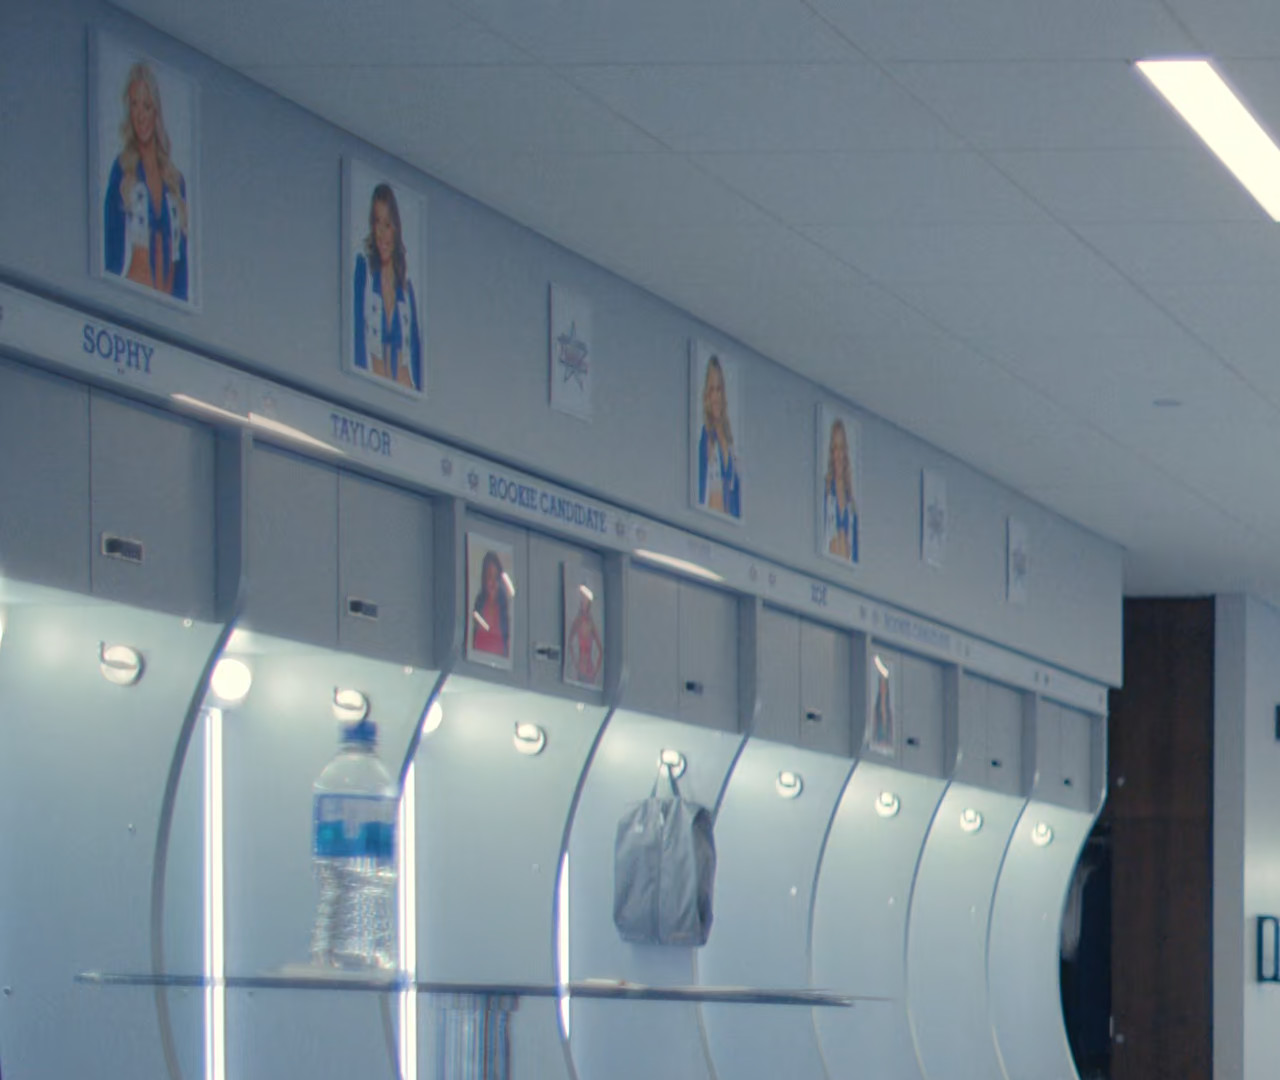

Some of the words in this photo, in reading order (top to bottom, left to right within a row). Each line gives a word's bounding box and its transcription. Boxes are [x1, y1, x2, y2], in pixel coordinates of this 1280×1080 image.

[83, 323, 153, 374] SOPHY
[330, 412, 391, 457] TAYLOR
[488, 474, 538, 510] ROOKIE
[540, 492, 607, 533] CANDIDATE
